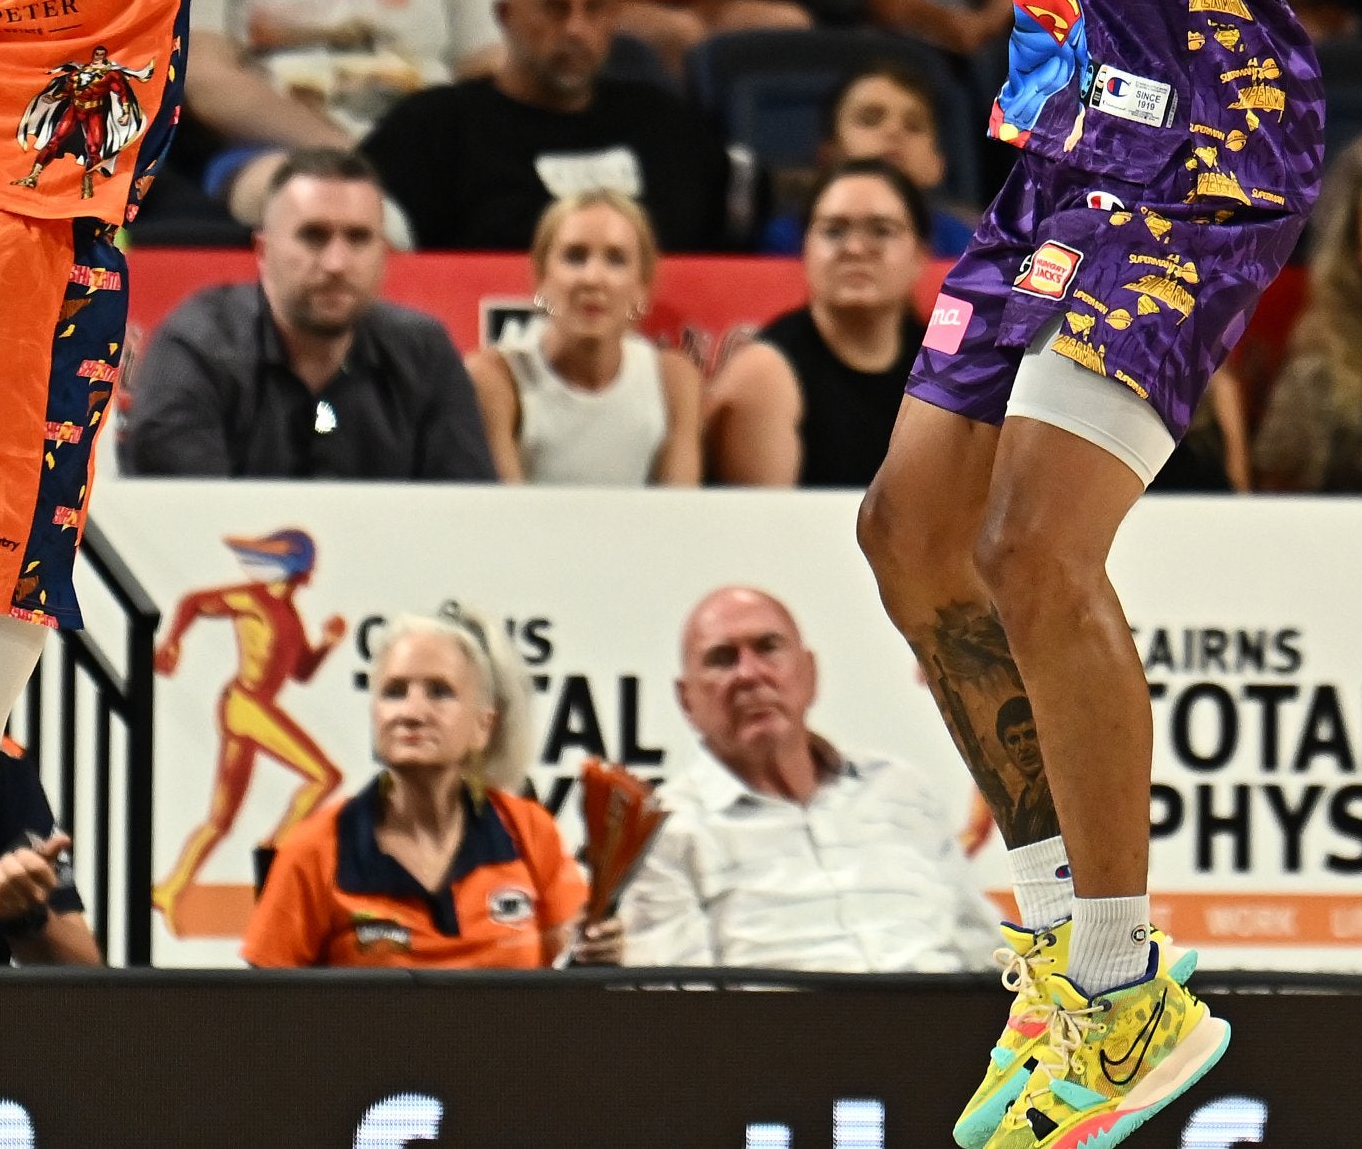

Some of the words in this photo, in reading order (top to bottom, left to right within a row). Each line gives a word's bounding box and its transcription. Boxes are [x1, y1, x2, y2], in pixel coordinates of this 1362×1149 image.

[1136, 90, 1161, 104] SINCE
[1137, 100, 1156, 111] 1919
[1036, 258, 1067, 274] HUNGRY
[1073, 288, 1109, 315] UPERMAN
[1131, 626, 1303, 674] AIRNS
